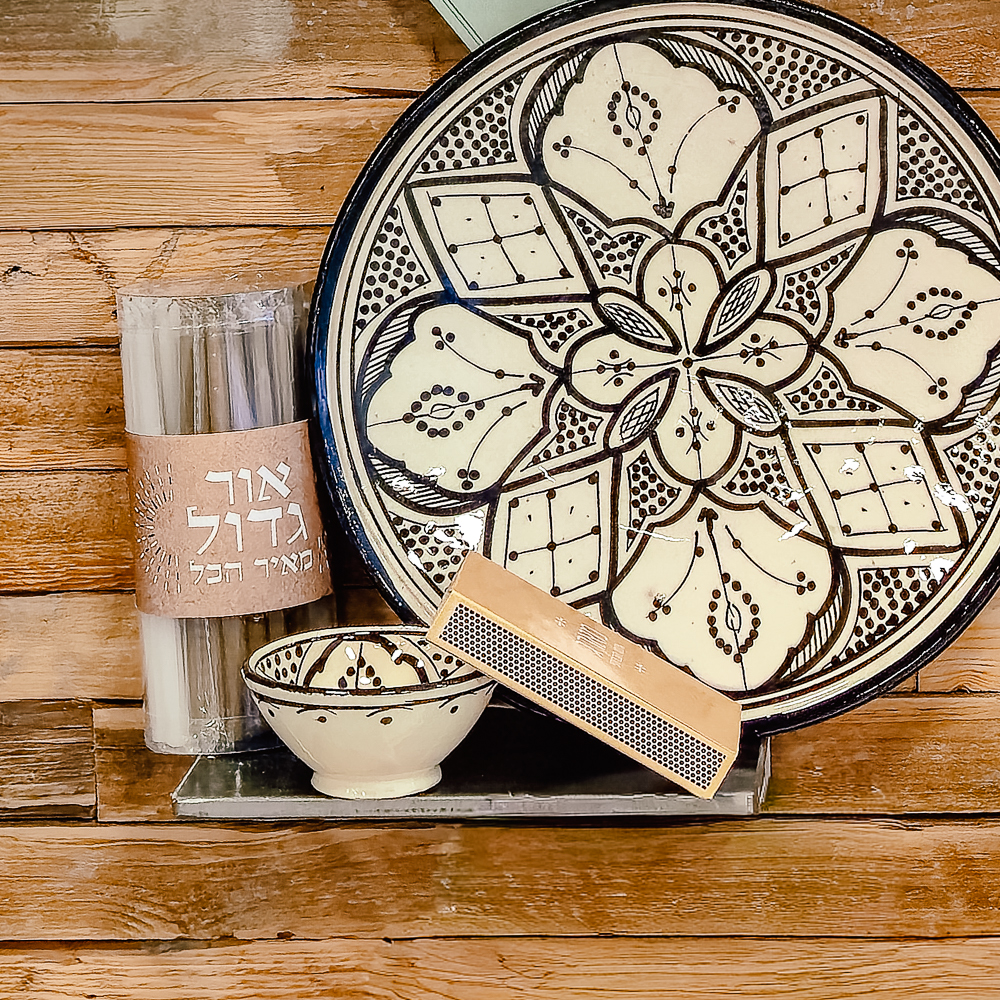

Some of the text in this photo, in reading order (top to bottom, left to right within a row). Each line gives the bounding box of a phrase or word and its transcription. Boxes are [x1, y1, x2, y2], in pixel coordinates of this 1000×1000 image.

[205, 461, 292, 505] אור
[187, 502, 308, 555] גדול
[190, 549, 313, 585] מאיר הכל
